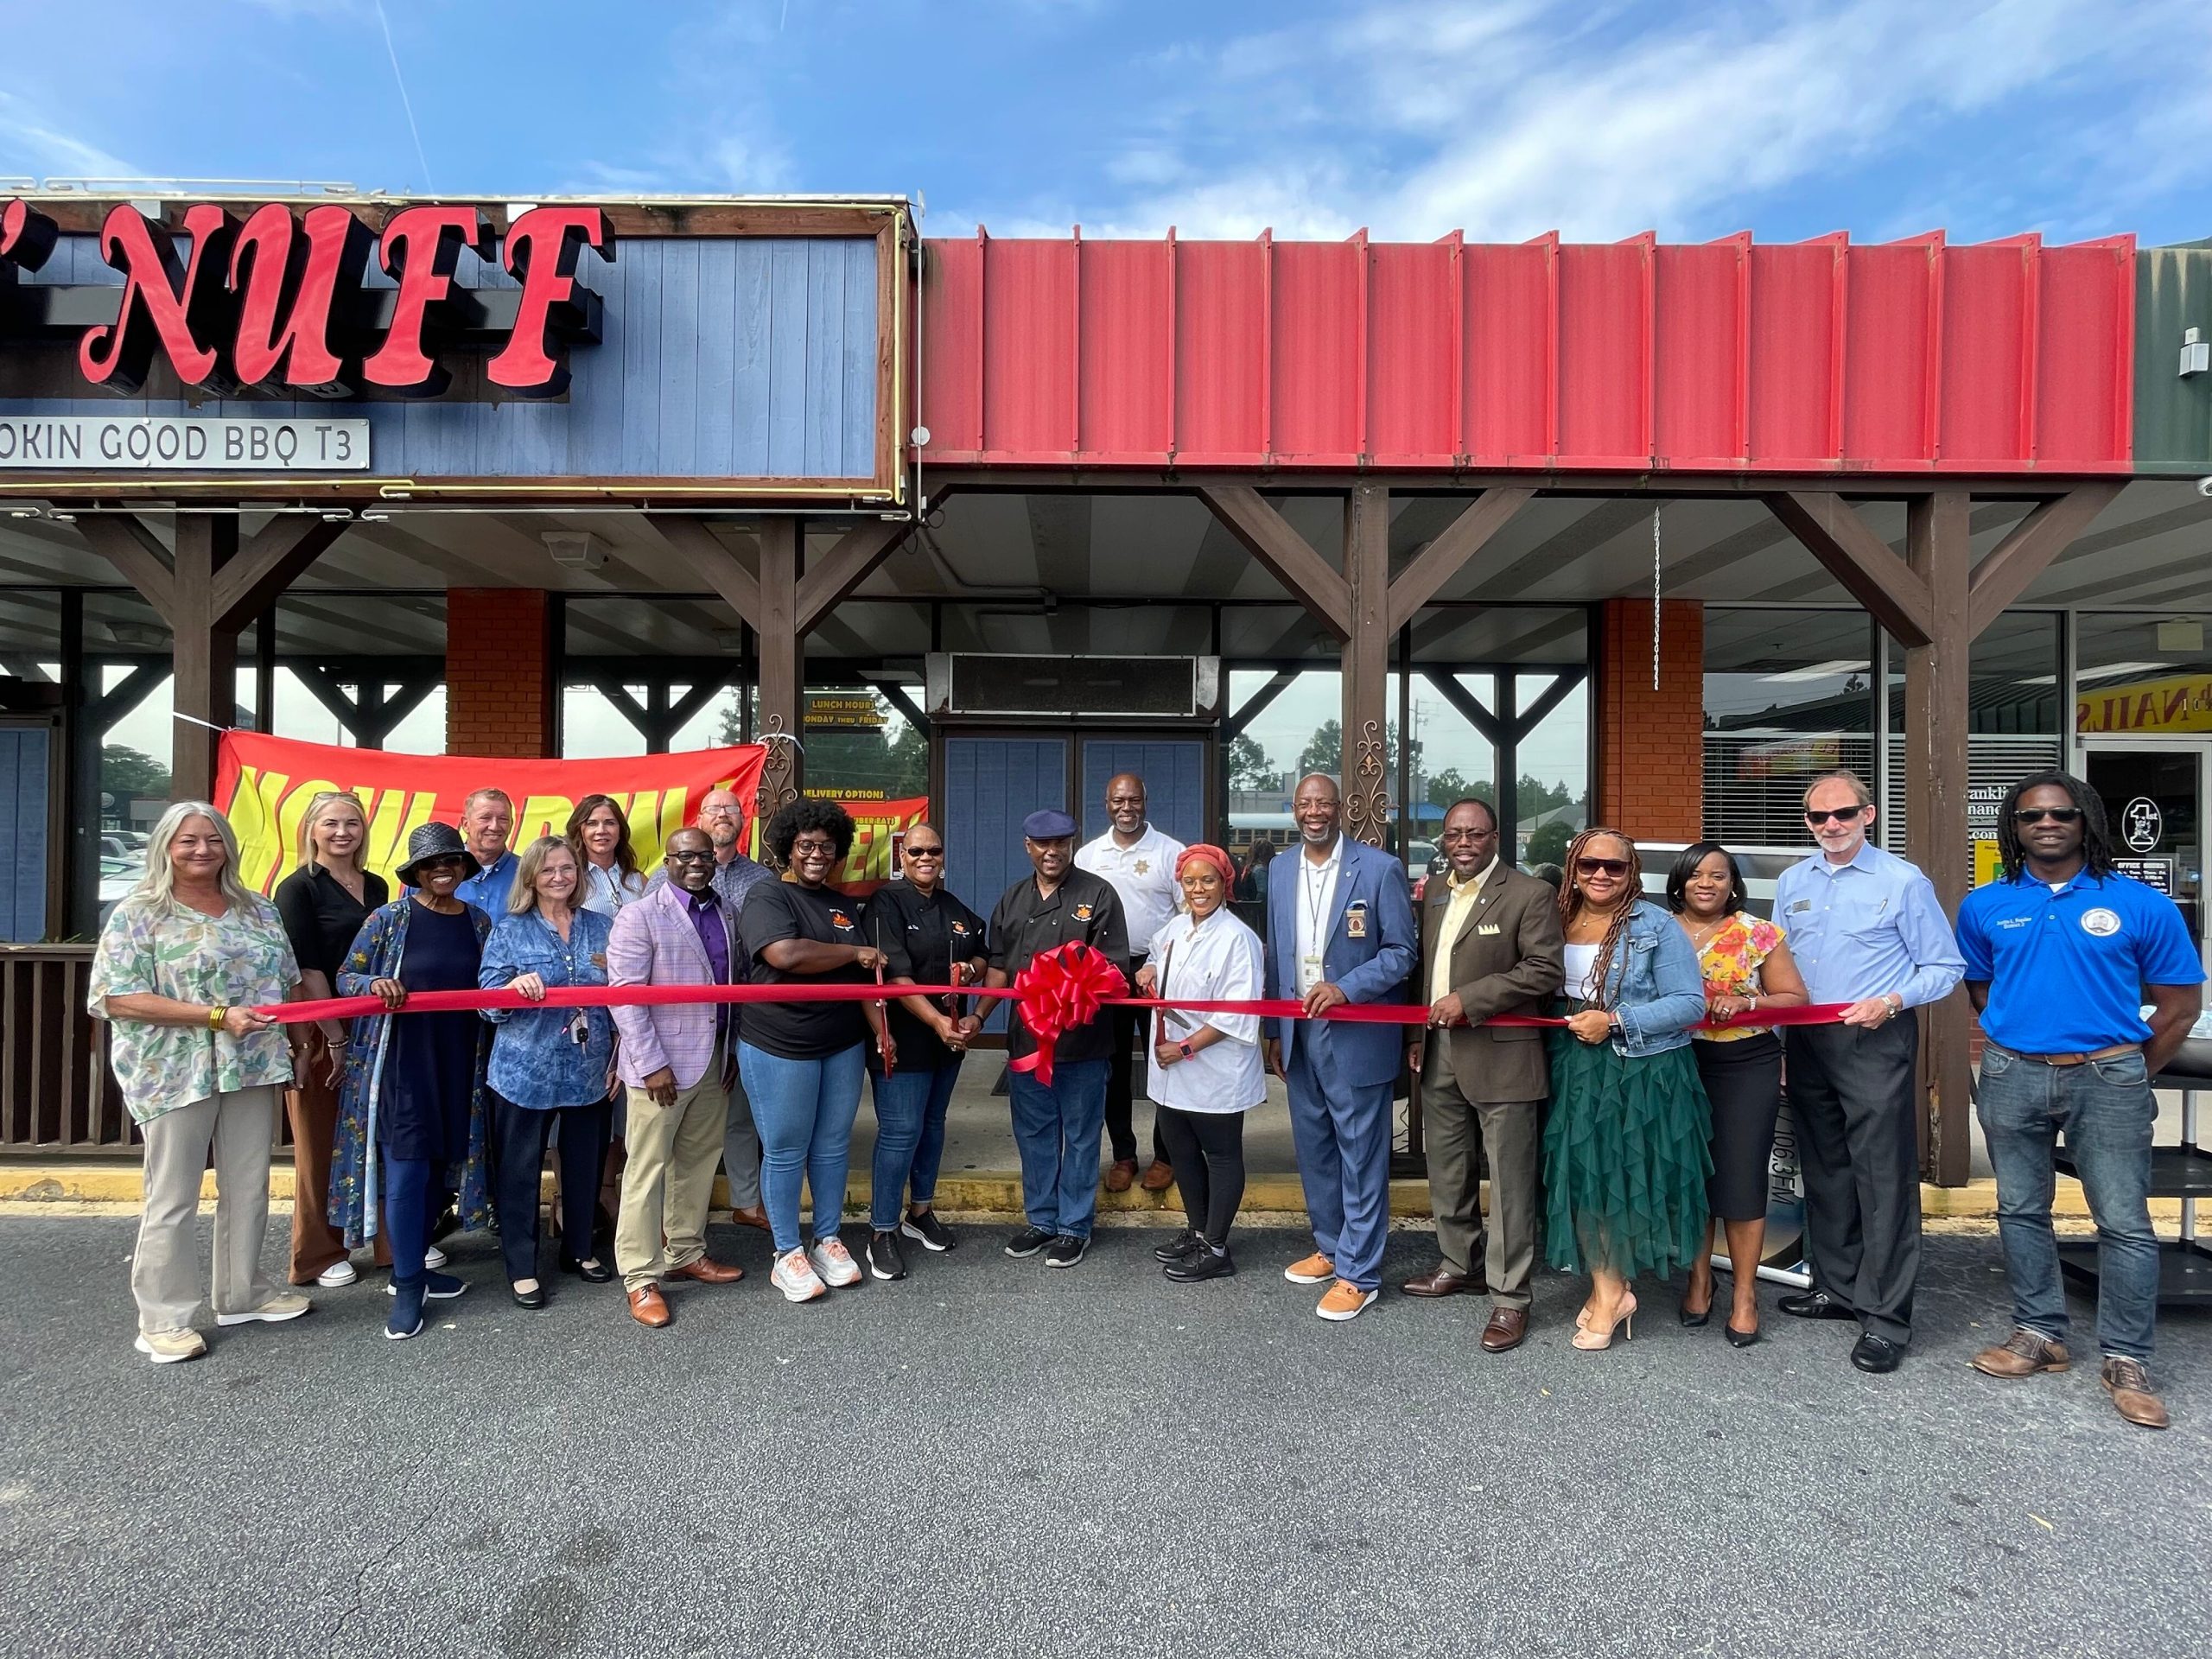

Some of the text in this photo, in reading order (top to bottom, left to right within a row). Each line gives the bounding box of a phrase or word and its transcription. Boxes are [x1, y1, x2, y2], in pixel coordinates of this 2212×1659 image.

[100, 424, 207, 461] GOOD
[226, 426, 297, 467] BBQ
[315, 426, 352, 461] T3
[812, 700, 874, 709] LUNCH HOURS
[845, 790, 884, 798] OPTIONS
[1967, 786, 2009, 799] ankli
[1967, 805, 2002, 815] nanc
[1771, 1129, 1796, 1205] 106.3FM
